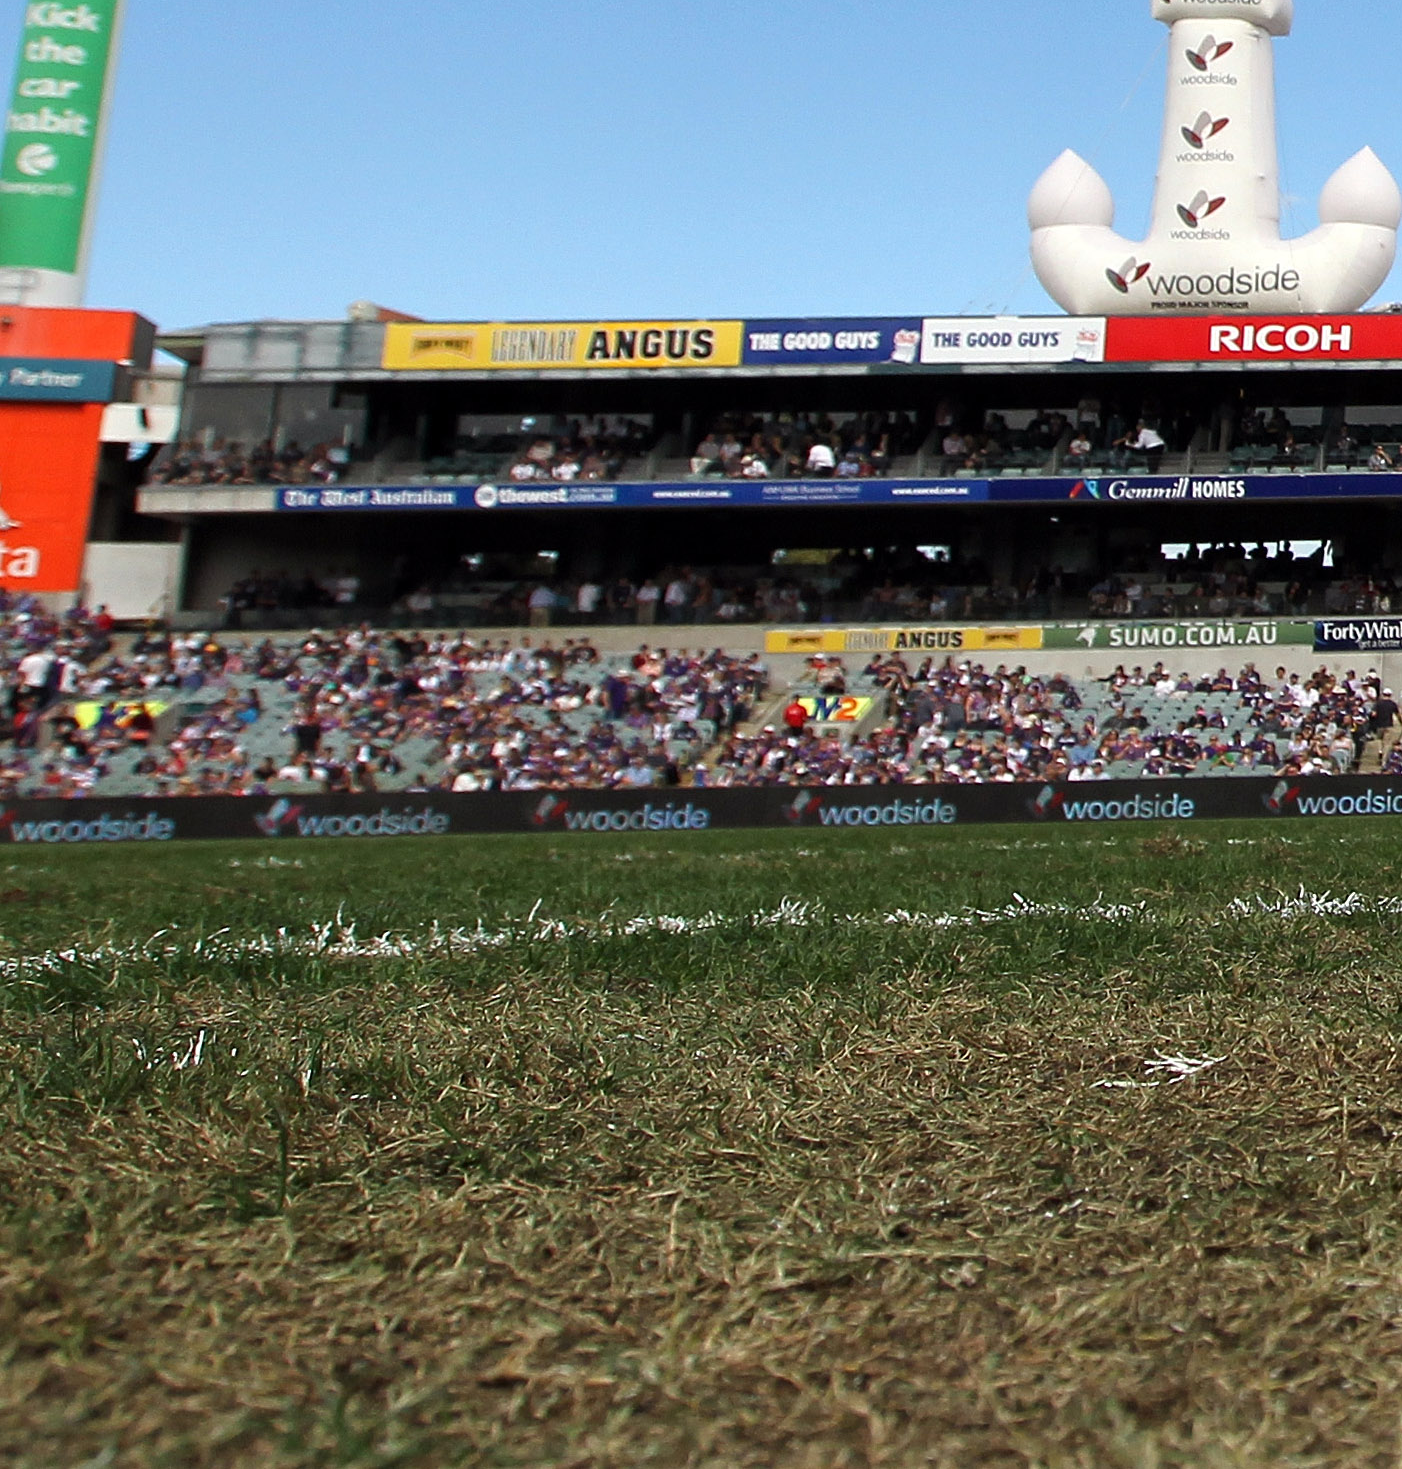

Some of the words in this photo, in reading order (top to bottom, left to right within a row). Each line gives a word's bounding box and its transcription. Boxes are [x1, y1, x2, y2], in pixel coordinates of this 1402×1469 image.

[25, 2, 100, 32] Kick
[24, 35, 87, 66] the
[18, 78, 82, 99] car
[1180, 73, 1237, 86] woodside
[1176, 150, 1234, 163] woodside
[1170, 229, 1230, 241] woodside
[1147, 264, 1300, 295] woodside
[585, 329, 714, 361] ANGUS
[749, 333, 780, 351] THE
[783, 332, 831, 351] GOOD
[834, 332, 881, 350] GUYS
[933, 332, 961, 348] THE
[966, 331, 1012, 347] GOOD
[1018, 331, 1061, 347] GUYS
[1209, 324, 1352, 352] RICOH
[10, 367, 83, 388] Partner
[283, 490, 317, 507] The
[320, 490, 367, 507] West
[370, 489, 456, 506] Australian
[1108, 478, 1190, 500] Gemmill
[1192, 480, 1245, 498] HOMES
[895, 631, 963, 648] ANGUS
[1109, 625, 1278, 647] SUMO.COM.AU
[1378, 639, 1400, 648] better
[565, 802, 711, 831] woodside
[819, 798, 957, 826] woodside
[1063, 793, 1195, 821] woodside
[12, 811, 175, 842] woodside
[299, 806, 451, 836] woodside
